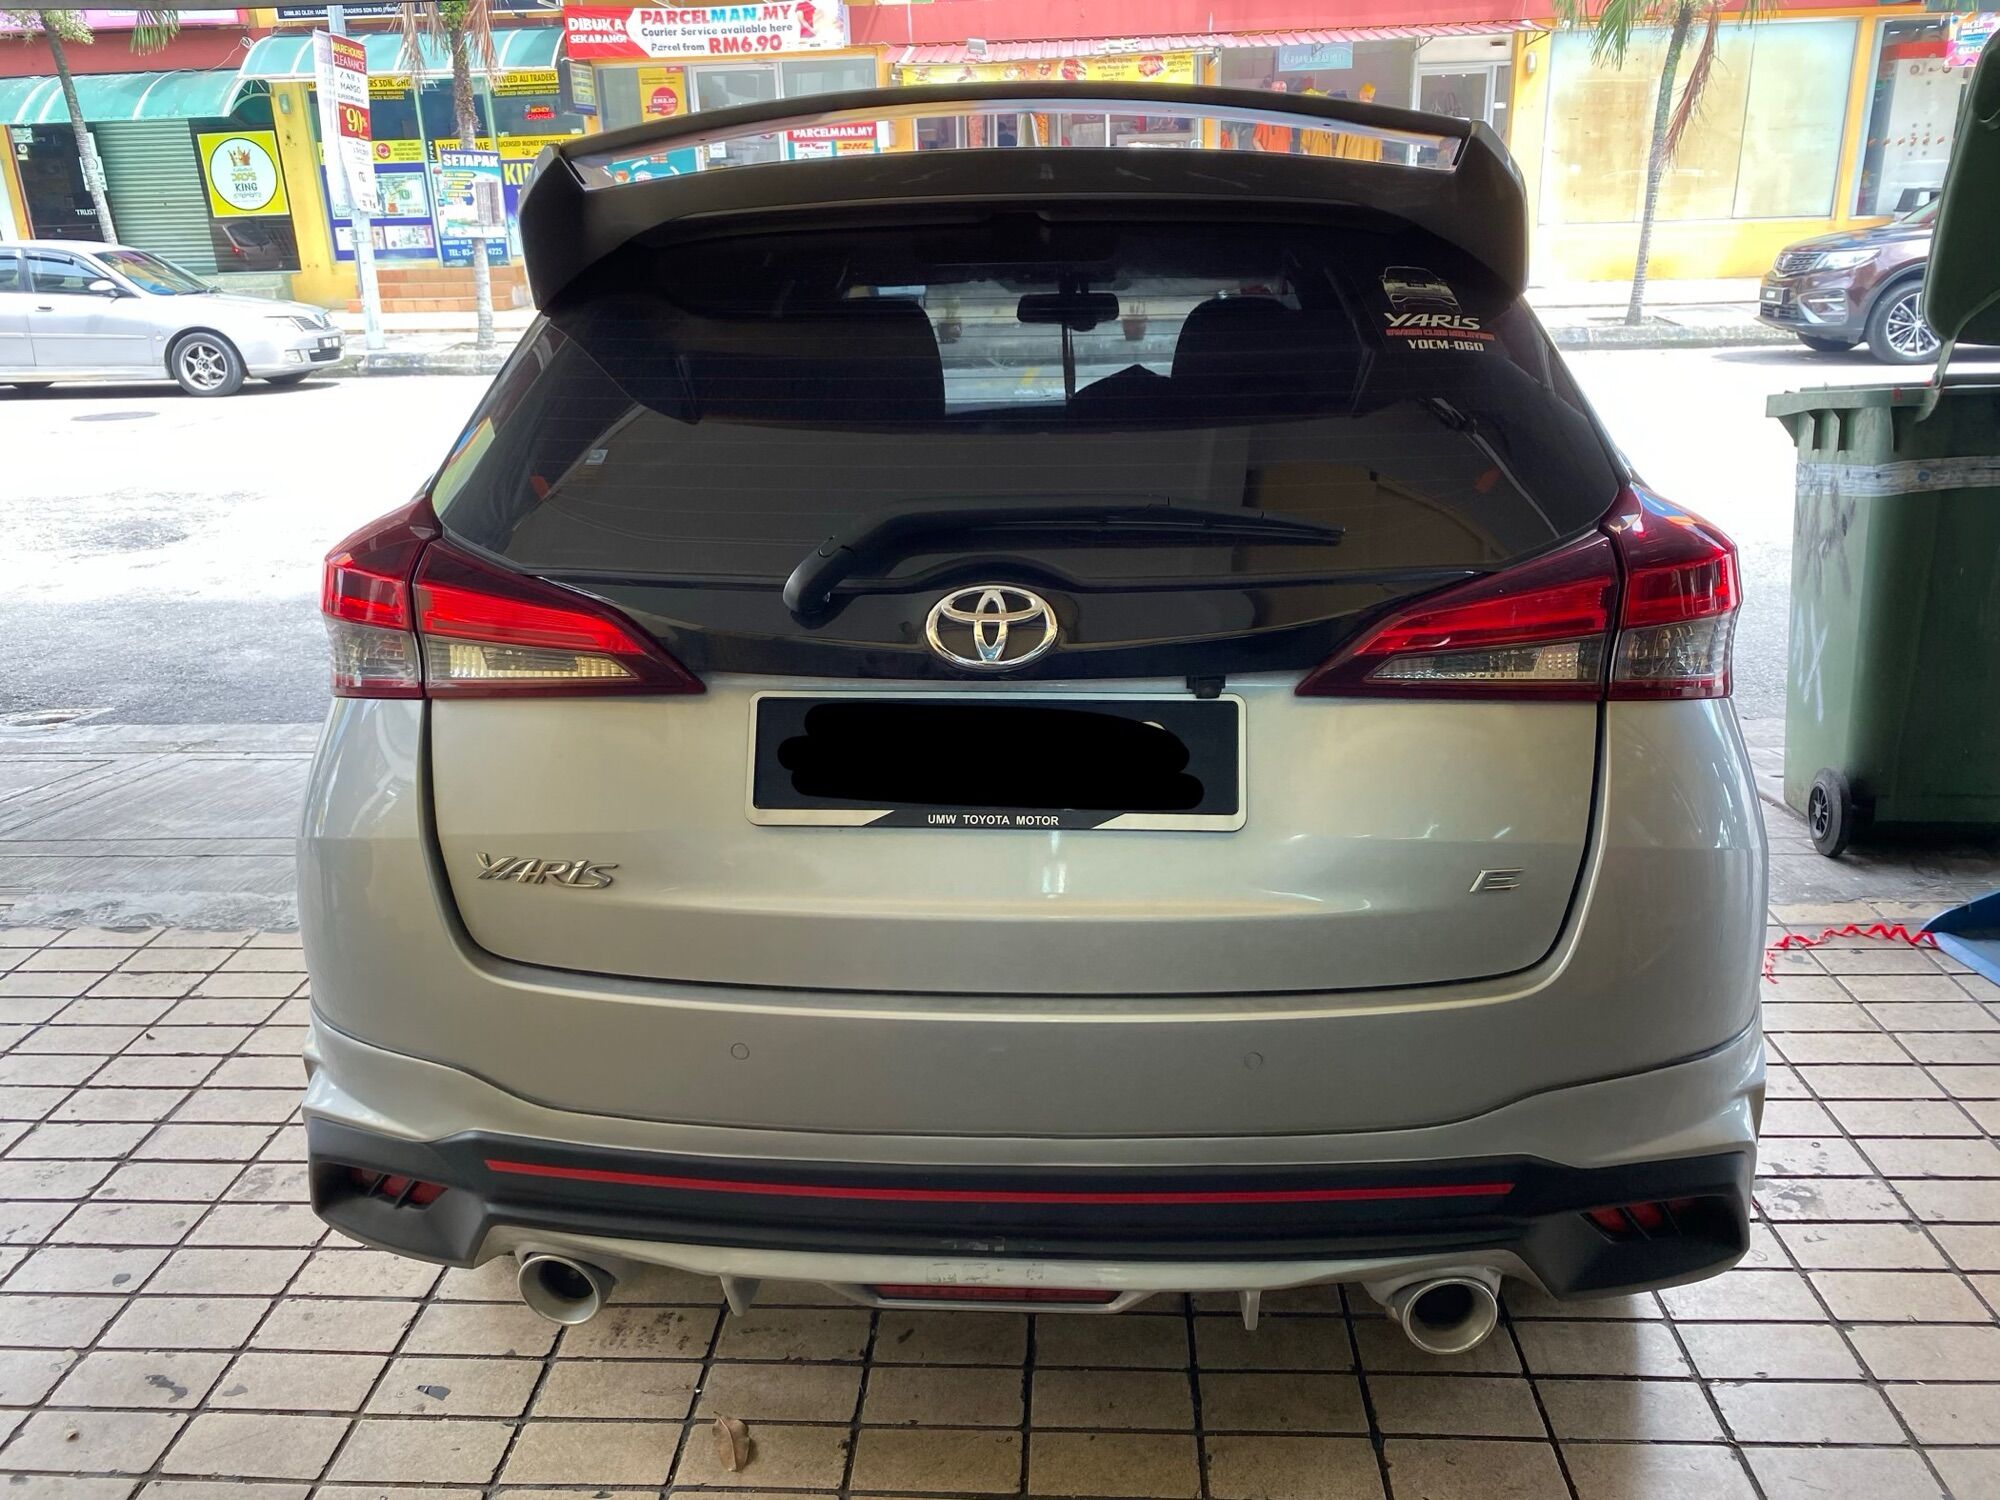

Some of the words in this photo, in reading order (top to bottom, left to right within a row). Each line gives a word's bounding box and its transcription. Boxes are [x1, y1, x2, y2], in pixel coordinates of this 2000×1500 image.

[640, 4, 791, 26] PARCELMAN.MY
[568, 17, 625, 31] DIBUKA
[641, 27, 678, 37] Courier
[680, 25, 718, 36] Service
[720, 24, 767, 35] available
[769, 23, 793, 32] here
[651, 42, 681, 52] Parcel
[682, 41, 705, 51] from
[708, 34, 783, 54] RM6.90
[333, 41, 365, 60] WAREHOUSE
[333, 53, 366, 72] CLEARANCE
[529, 72, 556, 81] TRADERS
[526, 112, 556, 120] CHANGER
[793, 126, 874, 138] PARCELMAN.MY
[842, 142, 868, 150] DHL
[442, 154, 500, 167] SETAPAK
[234, 182, 258, 192] KING
[75, 208, 97, 216] TRUST
[448, 248, 462, 257] TEL:
[927, 814, 957, 825] UMW
[962, 814, 1011, 826] TOYOTA
[1016, 815, 1060, 826] MOTOR
[1469, 867, 1525, 893] E
